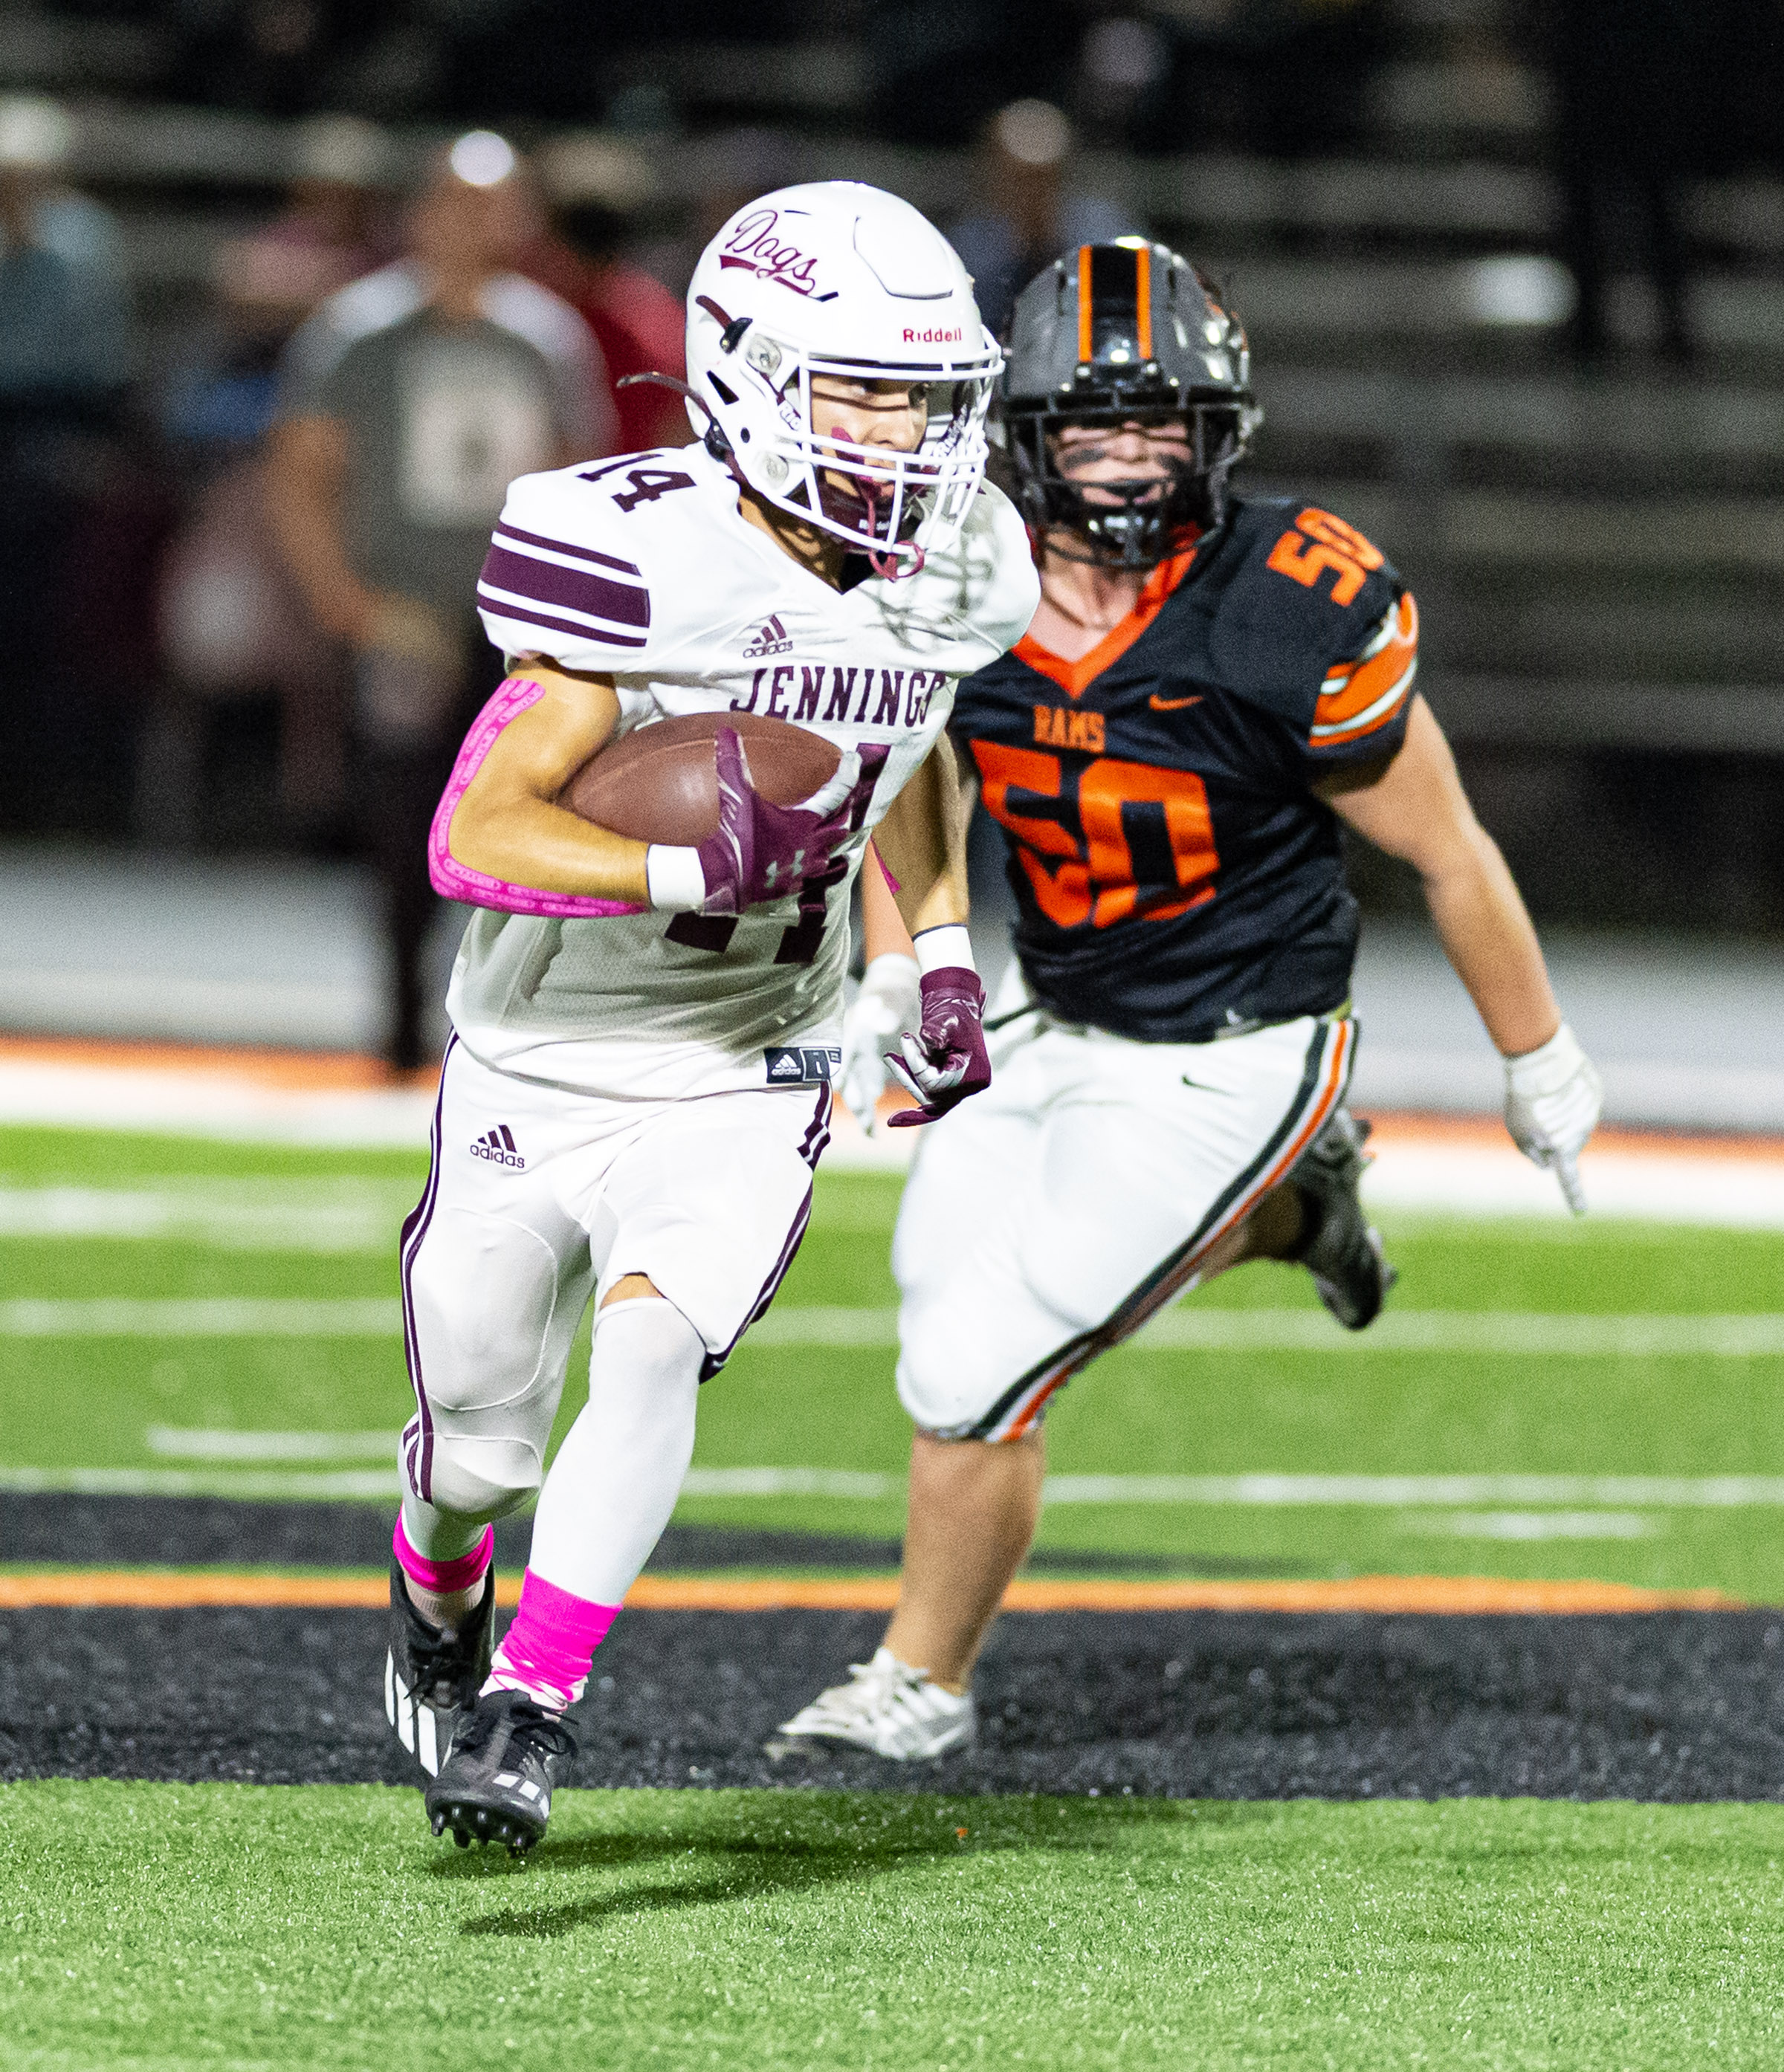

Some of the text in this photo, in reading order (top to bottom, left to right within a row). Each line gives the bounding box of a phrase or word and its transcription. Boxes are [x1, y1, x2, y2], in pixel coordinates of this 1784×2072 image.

[725, 210, 818, 296] Dogs
[903, 328, 962, 343] Riddell
[575, 453, 697, 513] 14
[1266, 507, 1385, 607] 50
[743, 641, 793, 658] adidas
[1032, 704, 1106, 754] RAMS
[969, 739, 1220, 928] 50
[470, 1145, 525, 1168] adidas
